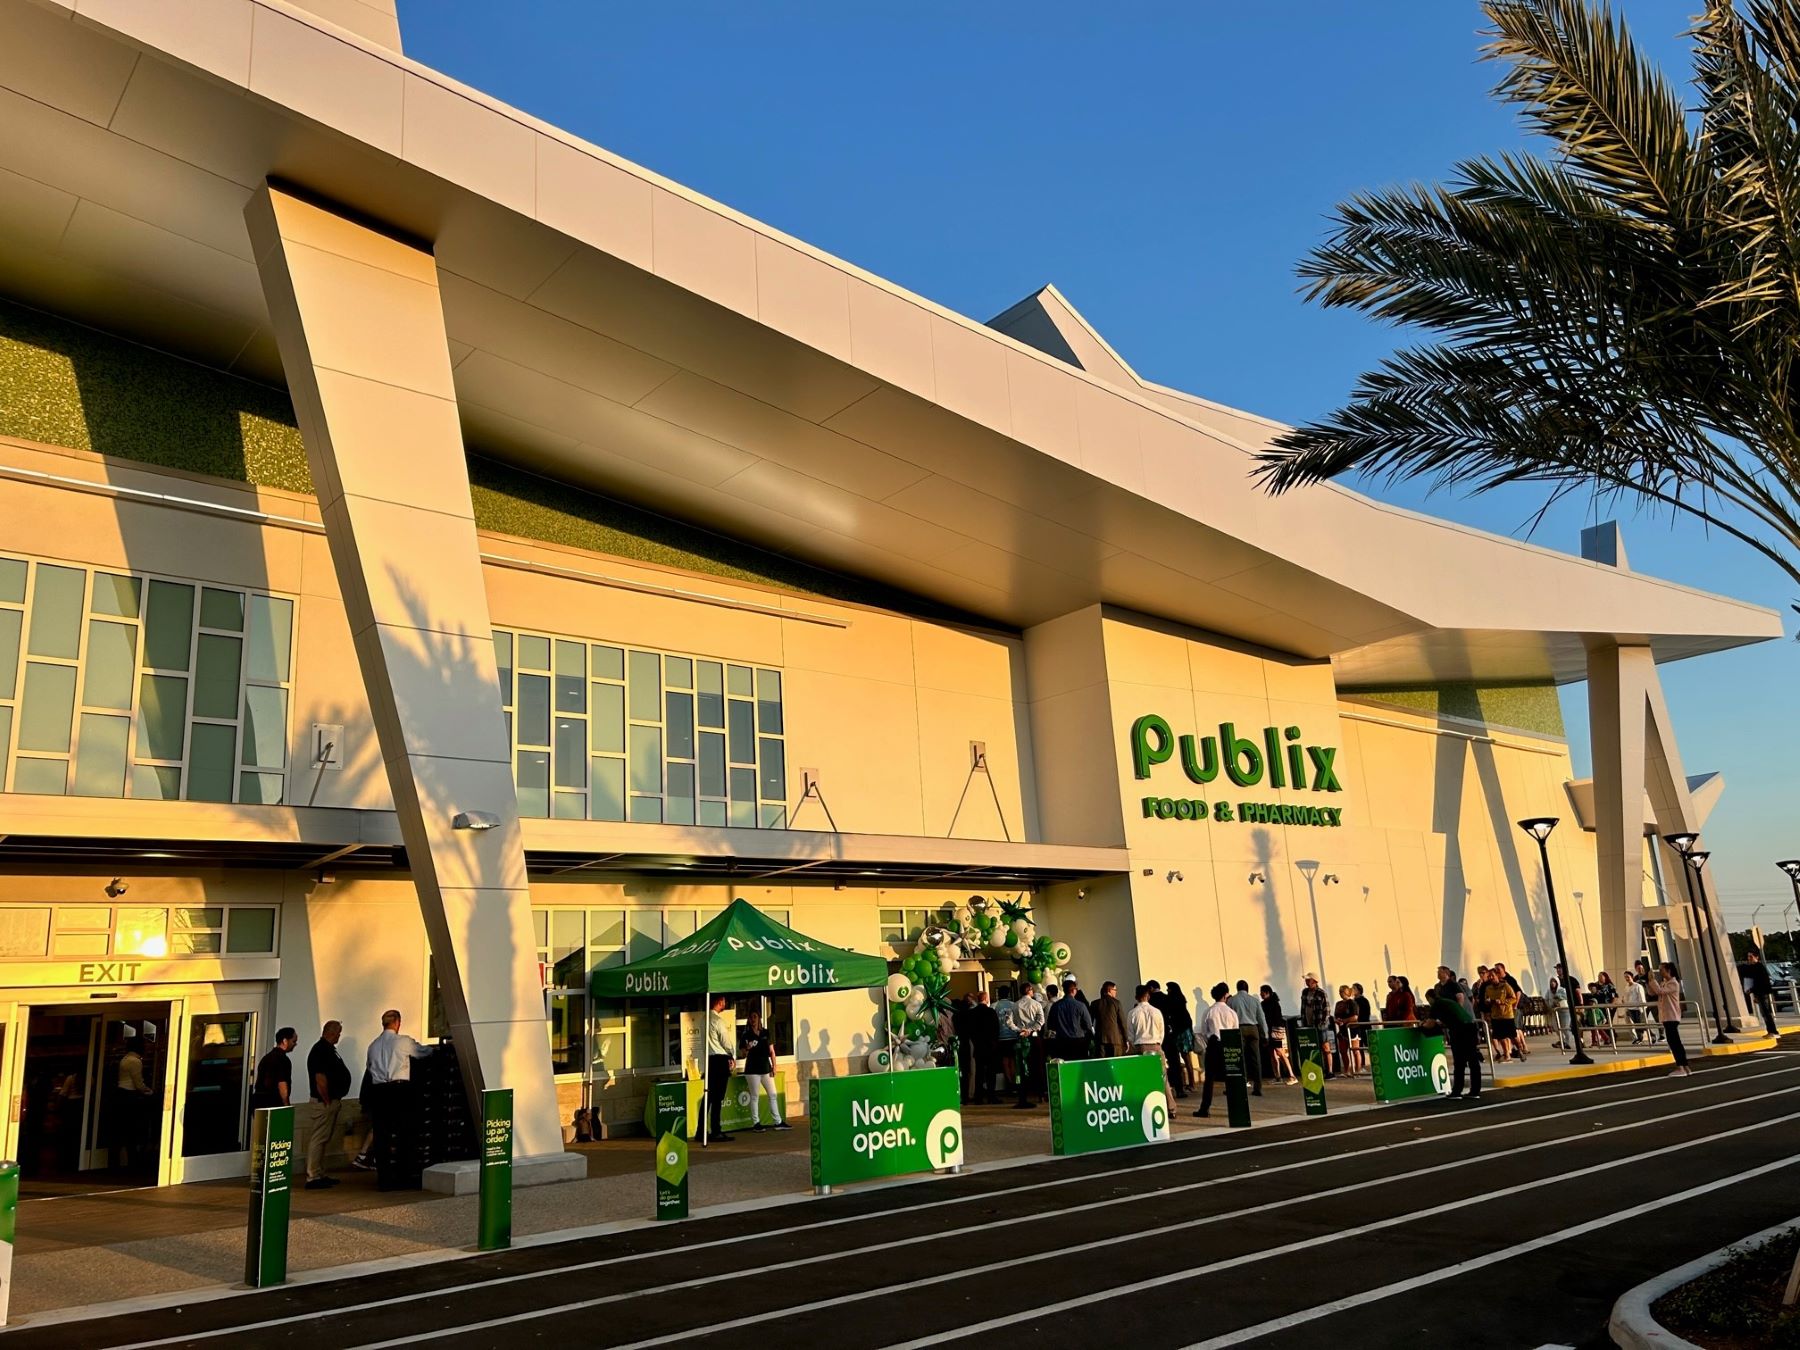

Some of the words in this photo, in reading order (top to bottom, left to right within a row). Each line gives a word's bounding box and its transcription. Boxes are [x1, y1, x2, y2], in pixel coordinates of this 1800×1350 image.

[1130, 713, 1343, 792] Publix
[1141, 796, 1209, 820] FOOD
[1213, 801, 1234, 822] &
[1239, 802, 1343, 827] PHARMACY
[79, 963, 141, 983] EXIT
[1394, 1044, 1419, 1063] Now
[1397, 1065, 1427, 1085] open.
[1083, 1081, 1123, 1105] Now
[852, 1099, 904, 1127] Now
[1086, 1106, 1134, 1133] open.
[486, 1119, 511, 1128] Picking
[486, 1129, 496, 1137] up
[270, 1140, 292, 1151] Picking
[485, 1133, 509, 1143] order?
[852, 1127, 916, 1159] open.
[269, 1151, 279, 1160] up
[269, 1156, 289, 1168] order?
